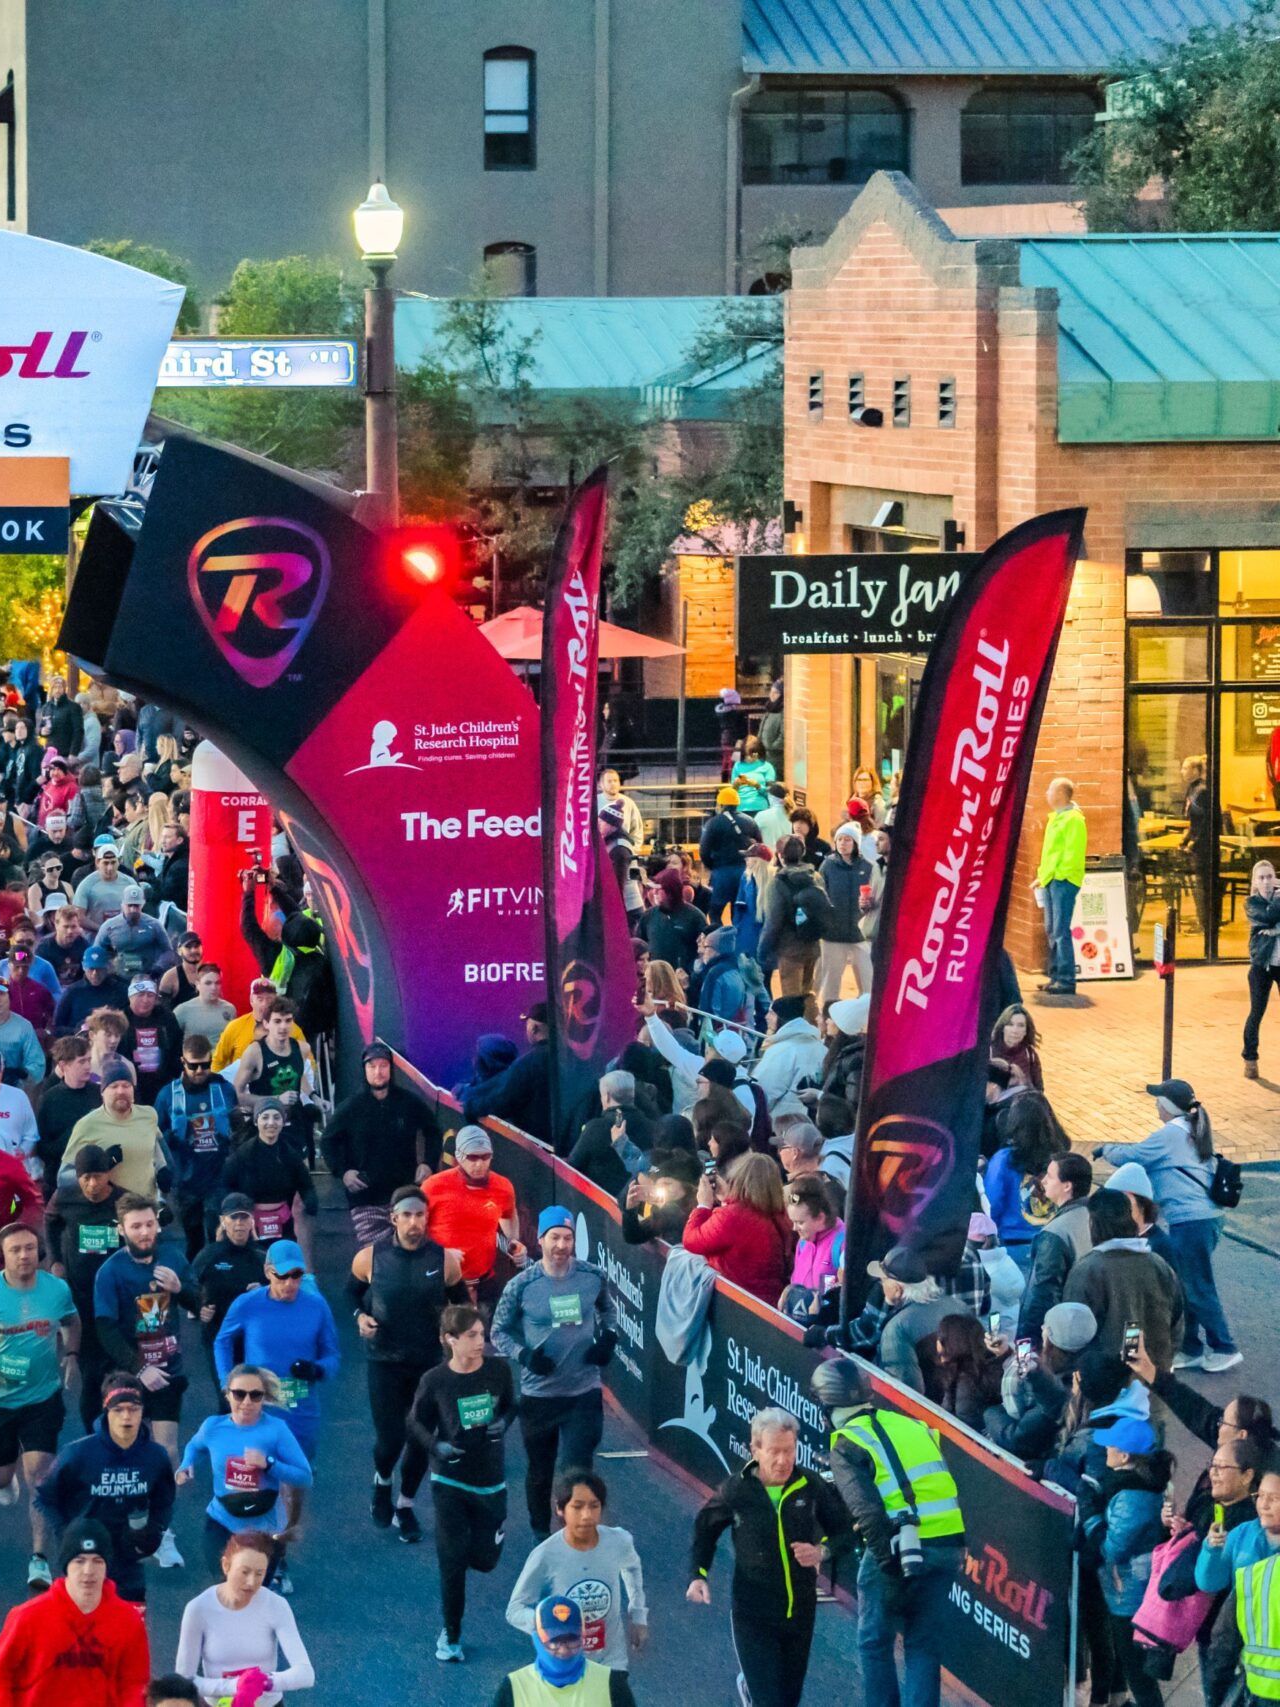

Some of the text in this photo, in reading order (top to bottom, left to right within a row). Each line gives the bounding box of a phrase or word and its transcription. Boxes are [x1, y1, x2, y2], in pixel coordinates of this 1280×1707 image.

[250, 349, 292, 377] St
[770, 566, 889, 619] Daily
[782, 631, 849, 645] breakfast
[863, 629, 903, 644] lunch
[414, 719, 520, 741] St. Jude Children's
[414, 735, 520, 753] Research Hospital
[989, 674, 1029, 807] SERIES
[237, 810, 257, 842] E
[401, 812, 462, 841] The
[467, 886, 545, 913] FITVIN
[945, 816, 994, 982] RUNNING
[726, 1337, 826, 1434] St. Jude Children's
[90, 1481, 148, 1496] MOUNTAIN
[101, 1470, 141, 1485] EAGLE
[232, 1472, 253, 1482] 1471
[973, 1599, 1031, 1660] SERIES
